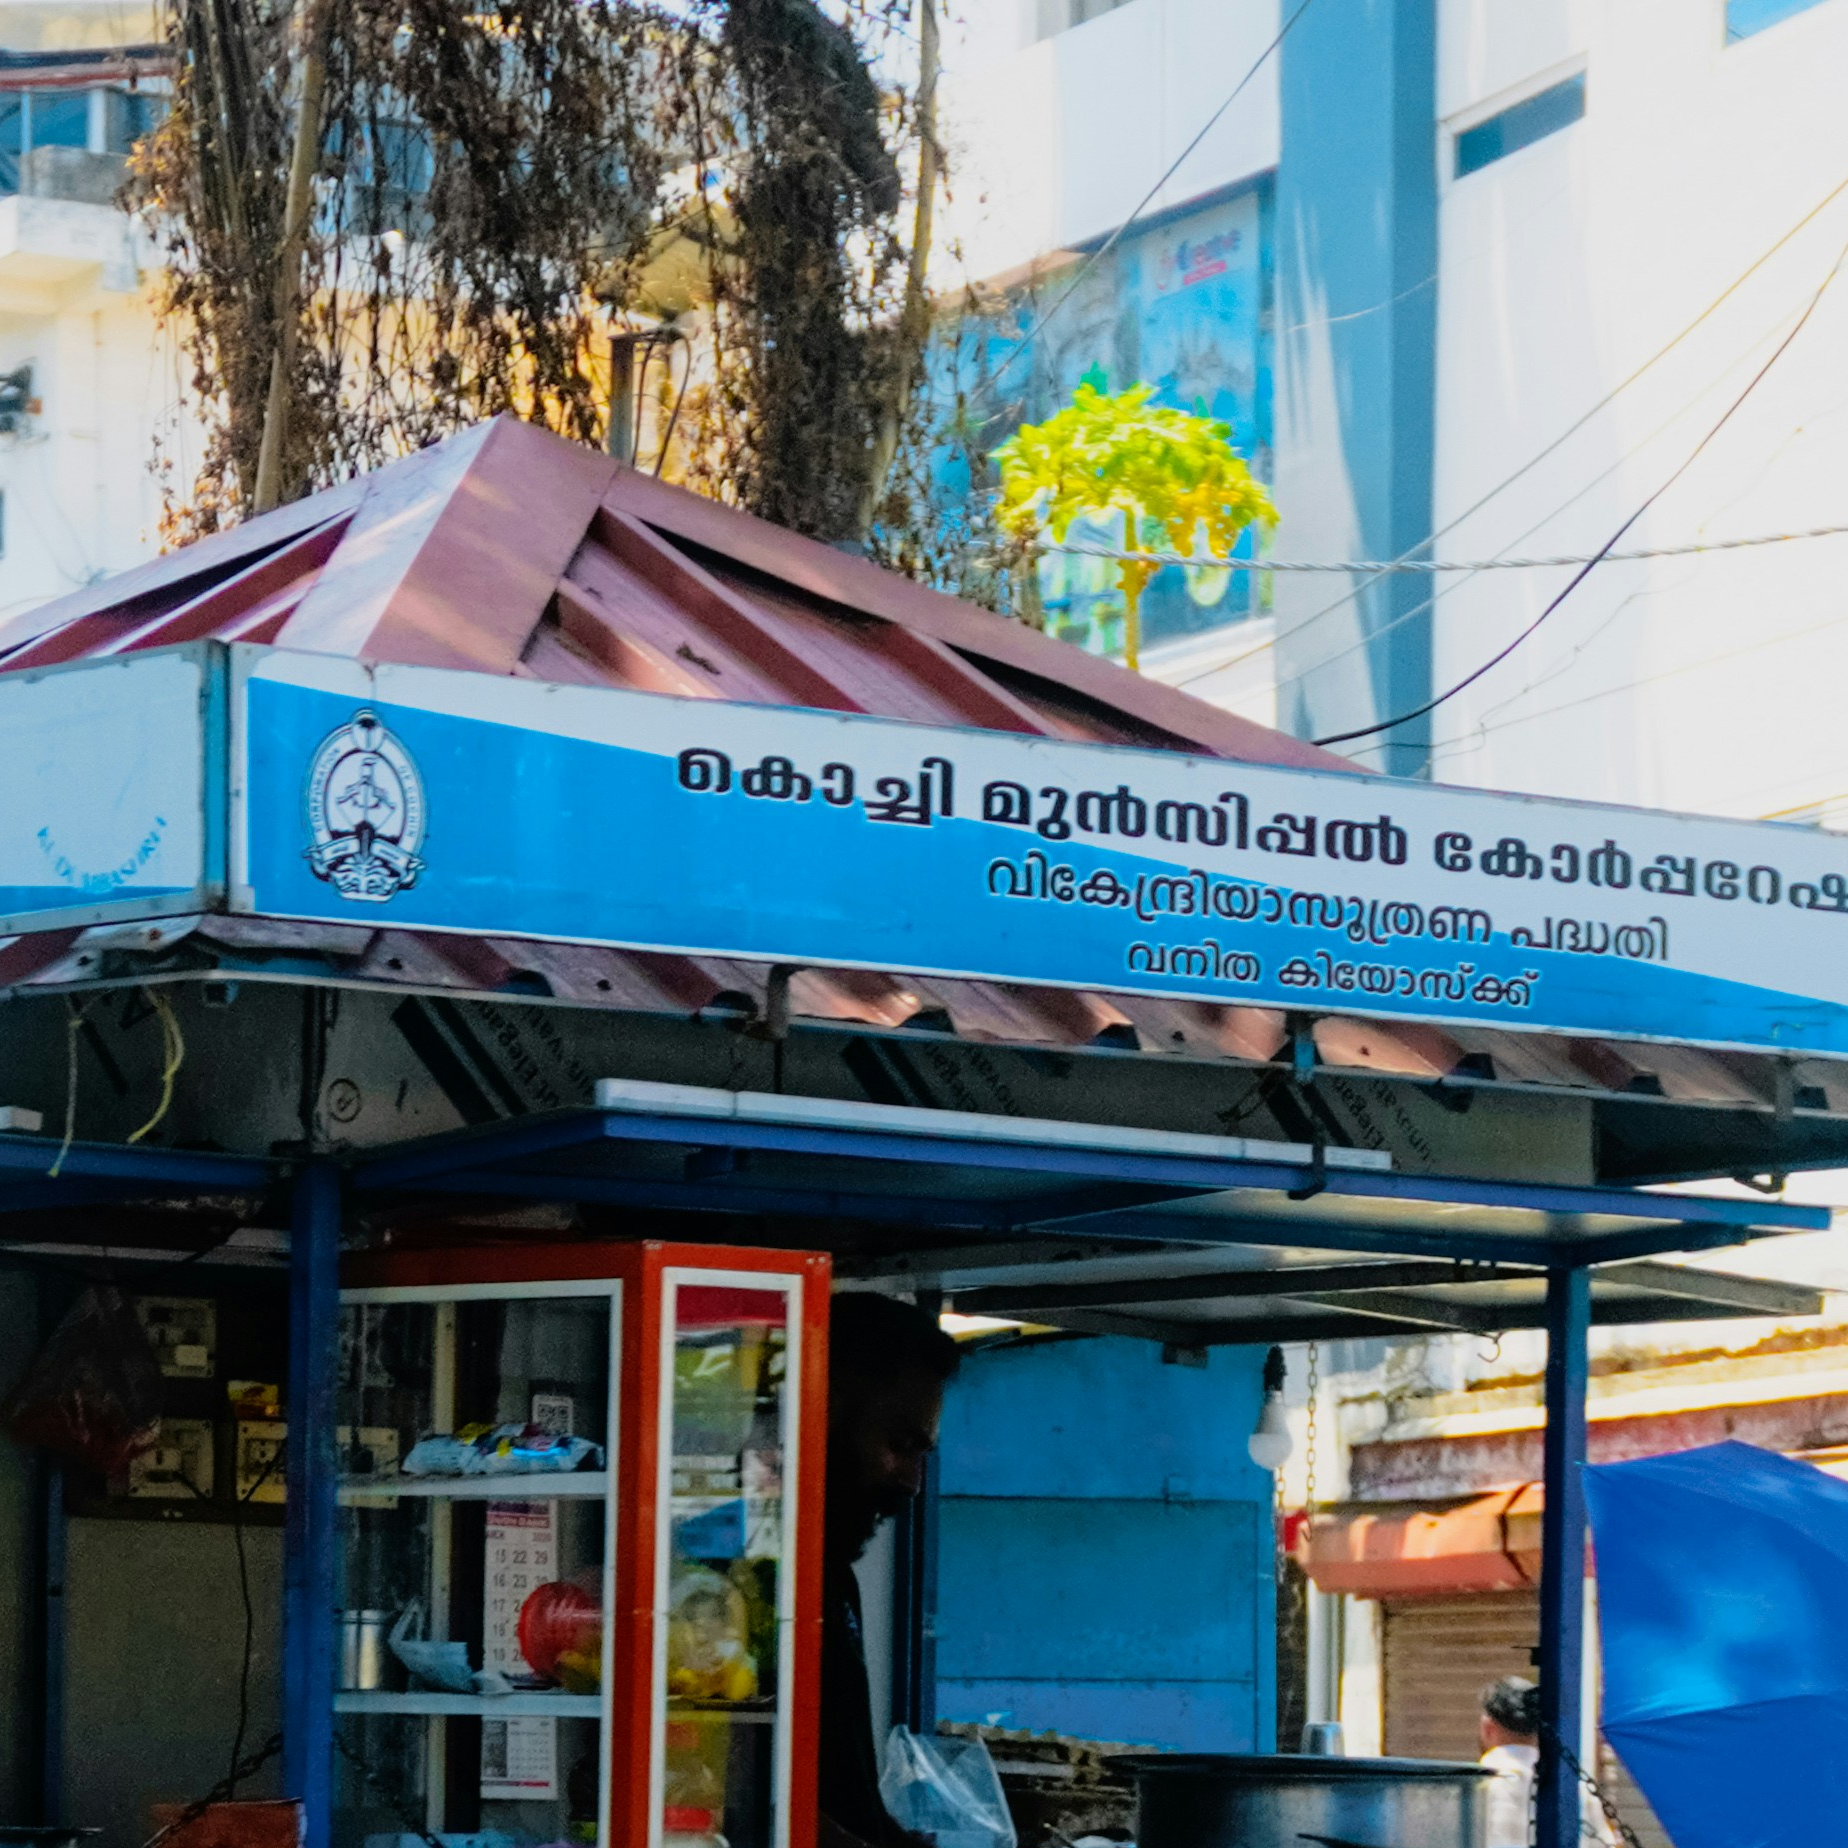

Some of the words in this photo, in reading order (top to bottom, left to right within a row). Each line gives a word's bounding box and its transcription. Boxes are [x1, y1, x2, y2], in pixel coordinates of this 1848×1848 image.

[676, 746, 956, 827] കൊച്ചി
[1509, 915, 1669, 962] പദ്ധതി
[1127, 939, 1261, 984] വനിത
[511, 1549, 528, 1564] 22
[534, 1550, 549, 1565] 29
[512, 1574, 528, 1589] 23
